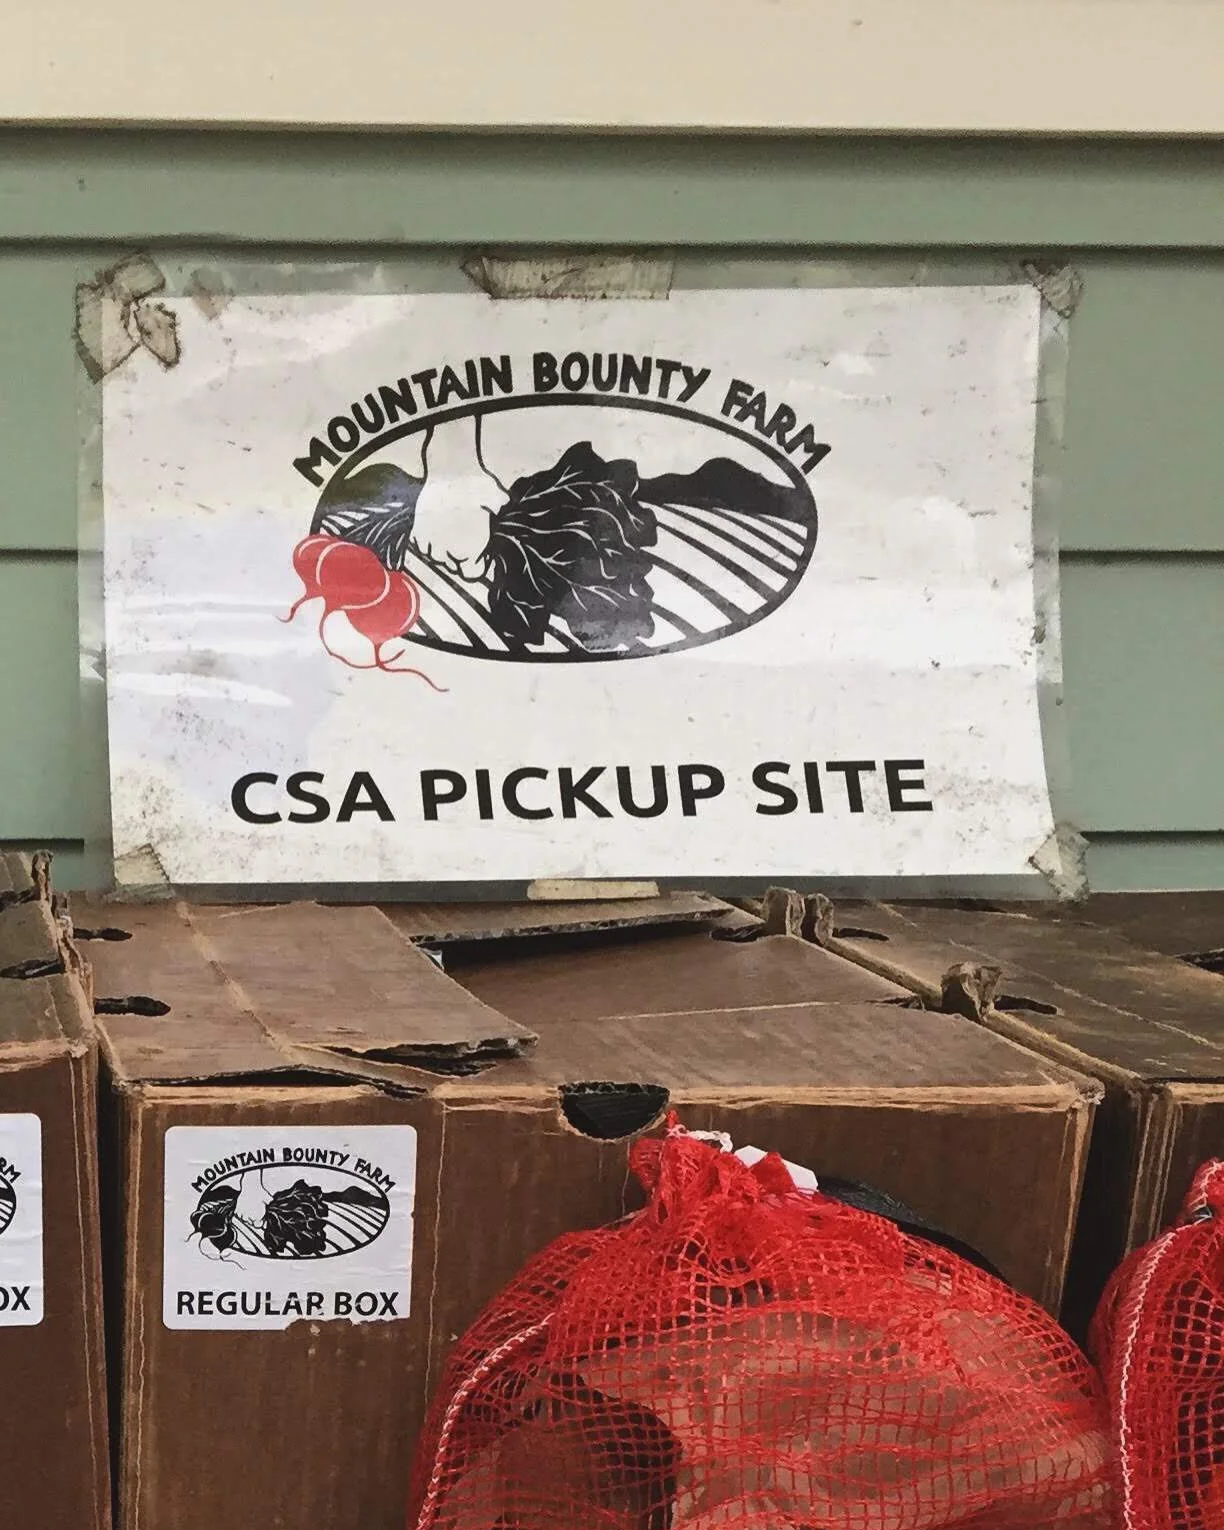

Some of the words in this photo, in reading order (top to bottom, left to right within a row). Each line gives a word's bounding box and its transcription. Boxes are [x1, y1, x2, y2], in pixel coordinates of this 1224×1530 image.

[292, 352, 514, 490] MOUNTAIN
[533, 350, 712, 404] BOUNTY
[721, 380, 833, 474] FARM
[231, 770, 398, 826] CSA
[421, 763, 727, 822] PICKUP
[750, 758, 934, 818] SITE
[191, 1147, 276, 1194] MOUNTAIN
[282, 1147, 350, 1168] BOUNTY
[354, 1157, 396, 1193] FARM
[176, 1290, 326, 1316] REGULAR
[333, 1291, 400, 1317] BOX
